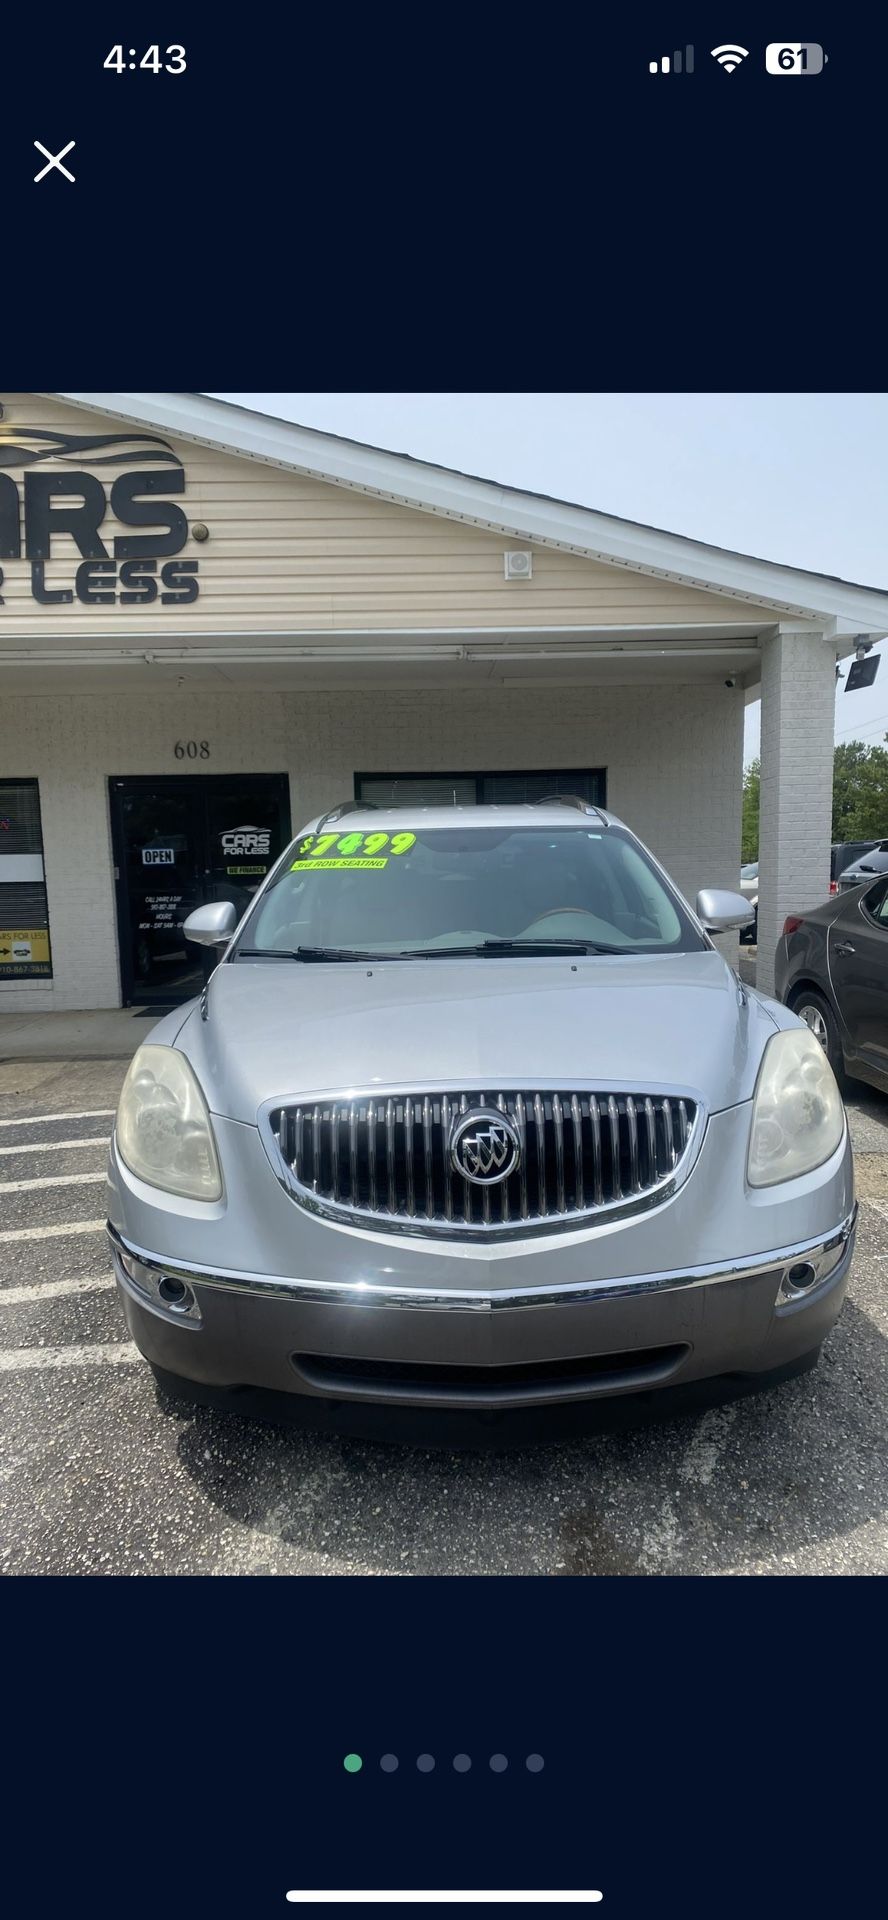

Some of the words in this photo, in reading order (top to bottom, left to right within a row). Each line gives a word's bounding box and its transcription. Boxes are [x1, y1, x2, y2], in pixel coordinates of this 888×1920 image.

[0, 469, 188, 559] RS
[31, 560, 199, 604] LESS
[174, 740, 210, 760] 608
[221, 834, 270, 848] CARS
[245, 847, 269, 855] LESS
[299, 832, 417, 856] $7499
[144, 851, 172, 863] OPEN
